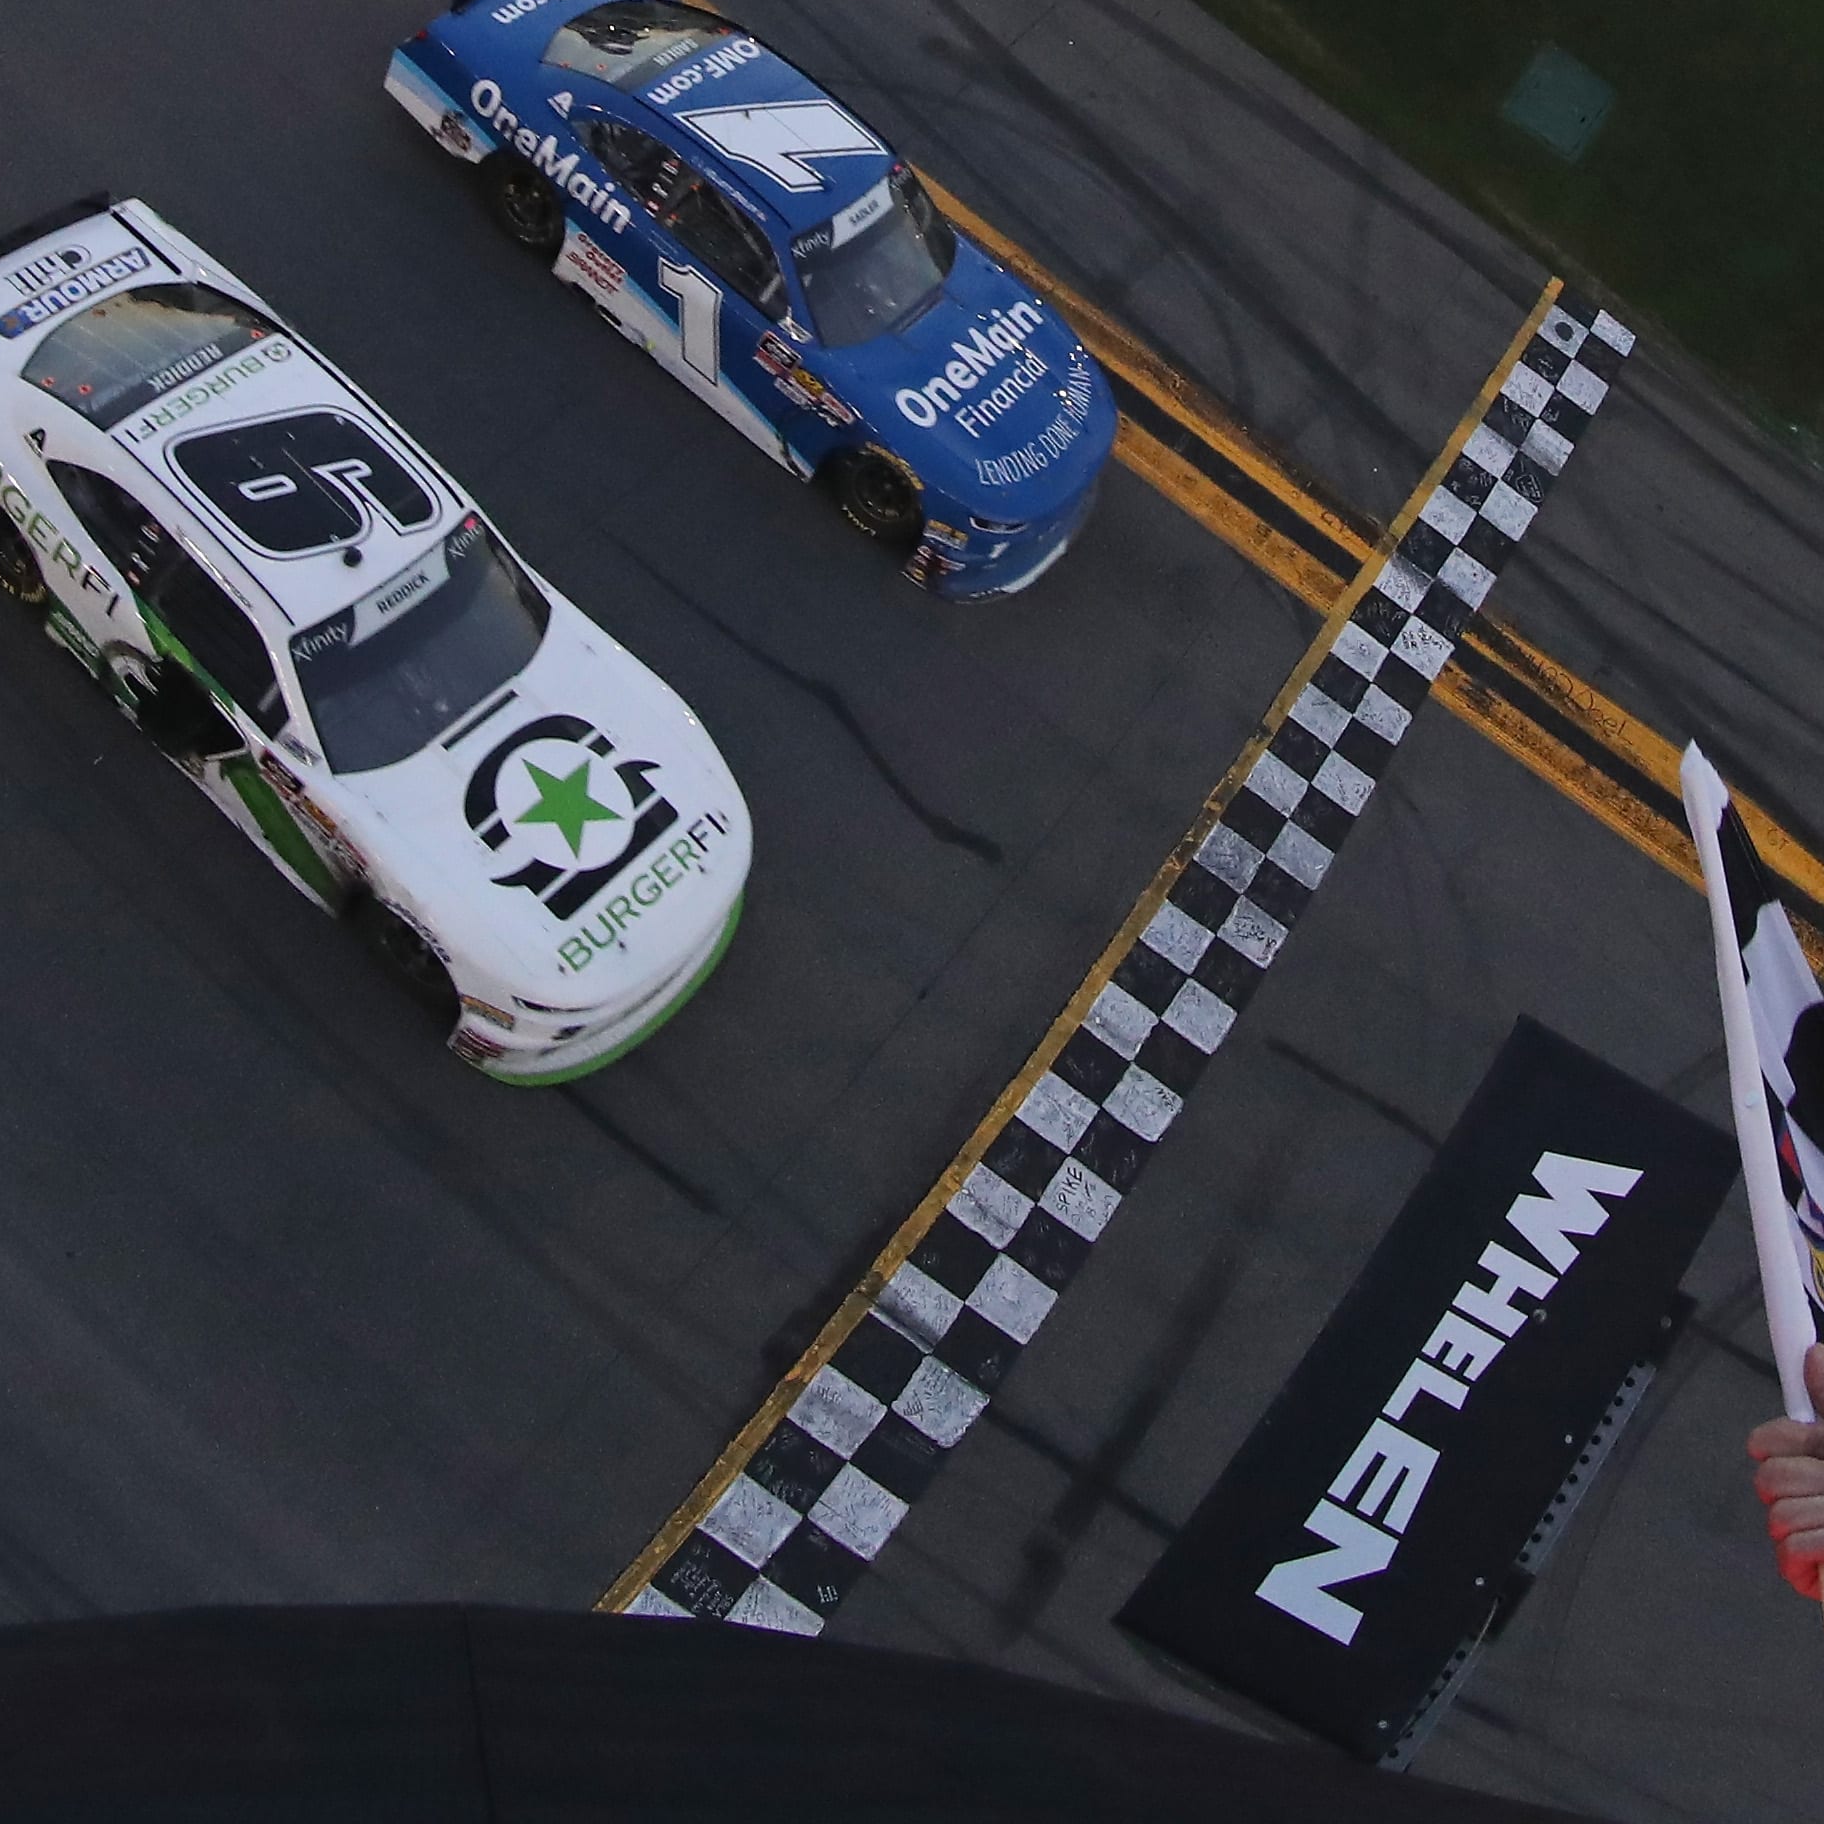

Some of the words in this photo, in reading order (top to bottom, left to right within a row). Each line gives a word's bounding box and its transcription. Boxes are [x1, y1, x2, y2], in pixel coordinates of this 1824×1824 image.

[646, 39, 762, 106] OMF.com
[470, 78, 633, 236] OneMain
[674, 100, 890, 193] 1
[3, 244, 92, 298] Chili
[25, 248, 149, 325] ARMOUR
[657, 256, 725, 387] 1
[894, 300, 1043, 428] OneMain
[130, 356, 266, 443] BURGERFI
[148, 341, 224, 392] REDDICK
[954, 349, 1050, 439] Financial
[975, 436, 1049, 487] LENDING
[1037, 413, 1080, 460] DONE
[376, 572, 431, 615] REDDICK
[557, 812, 727, 973] BURGERFI
[1253, 1150, 1644, 1647] WHELEN
